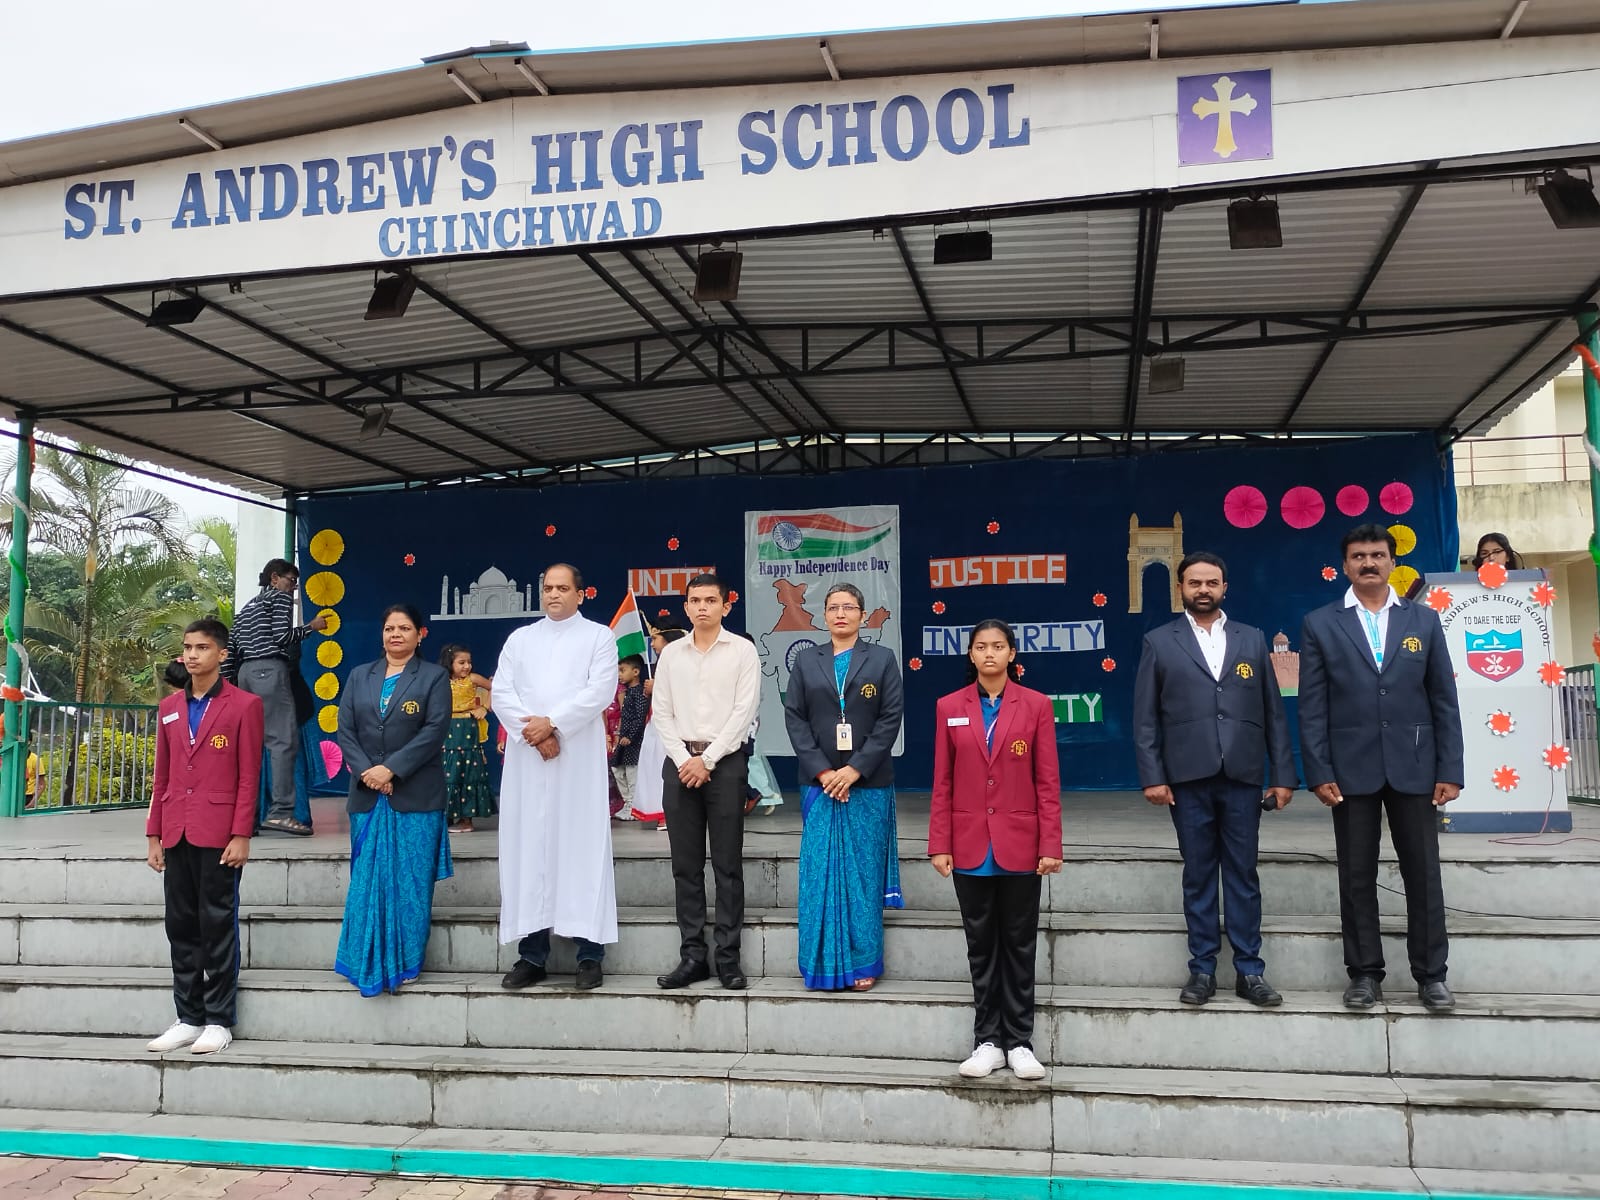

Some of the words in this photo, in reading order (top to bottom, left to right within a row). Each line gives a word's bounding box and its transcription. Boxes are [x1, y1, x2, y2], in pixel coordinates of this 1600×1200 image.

[64, 179, 142, 240] ST.
[171, 134, 496, 229] ANDREW'S
[530, 119, 705, 195] HIGH
[737, 83, 1031, 176] SCHOOL
[378, 196, 663, 258] CHINCHWAD
[628, 567, 715, 596] UNIT
[759, 561, 792, 577] Happy
[795, 558, 868, 576] Independence
[870, 556, 890, 573] Day
[930, 554, 1066, 587] JUSTICE
[1464, 616, 1472, 625] TO
[1473, 615, 1490, 625] DARE
[1491, 615, 1504, 625] THE
[1505, 614, 1522, 624] DEEP
[1493, 594, 1523, 608] HIGH
[1524, 606, 1550, 647] SCHOOL
[924, 622, 1103, 655] INRITY
